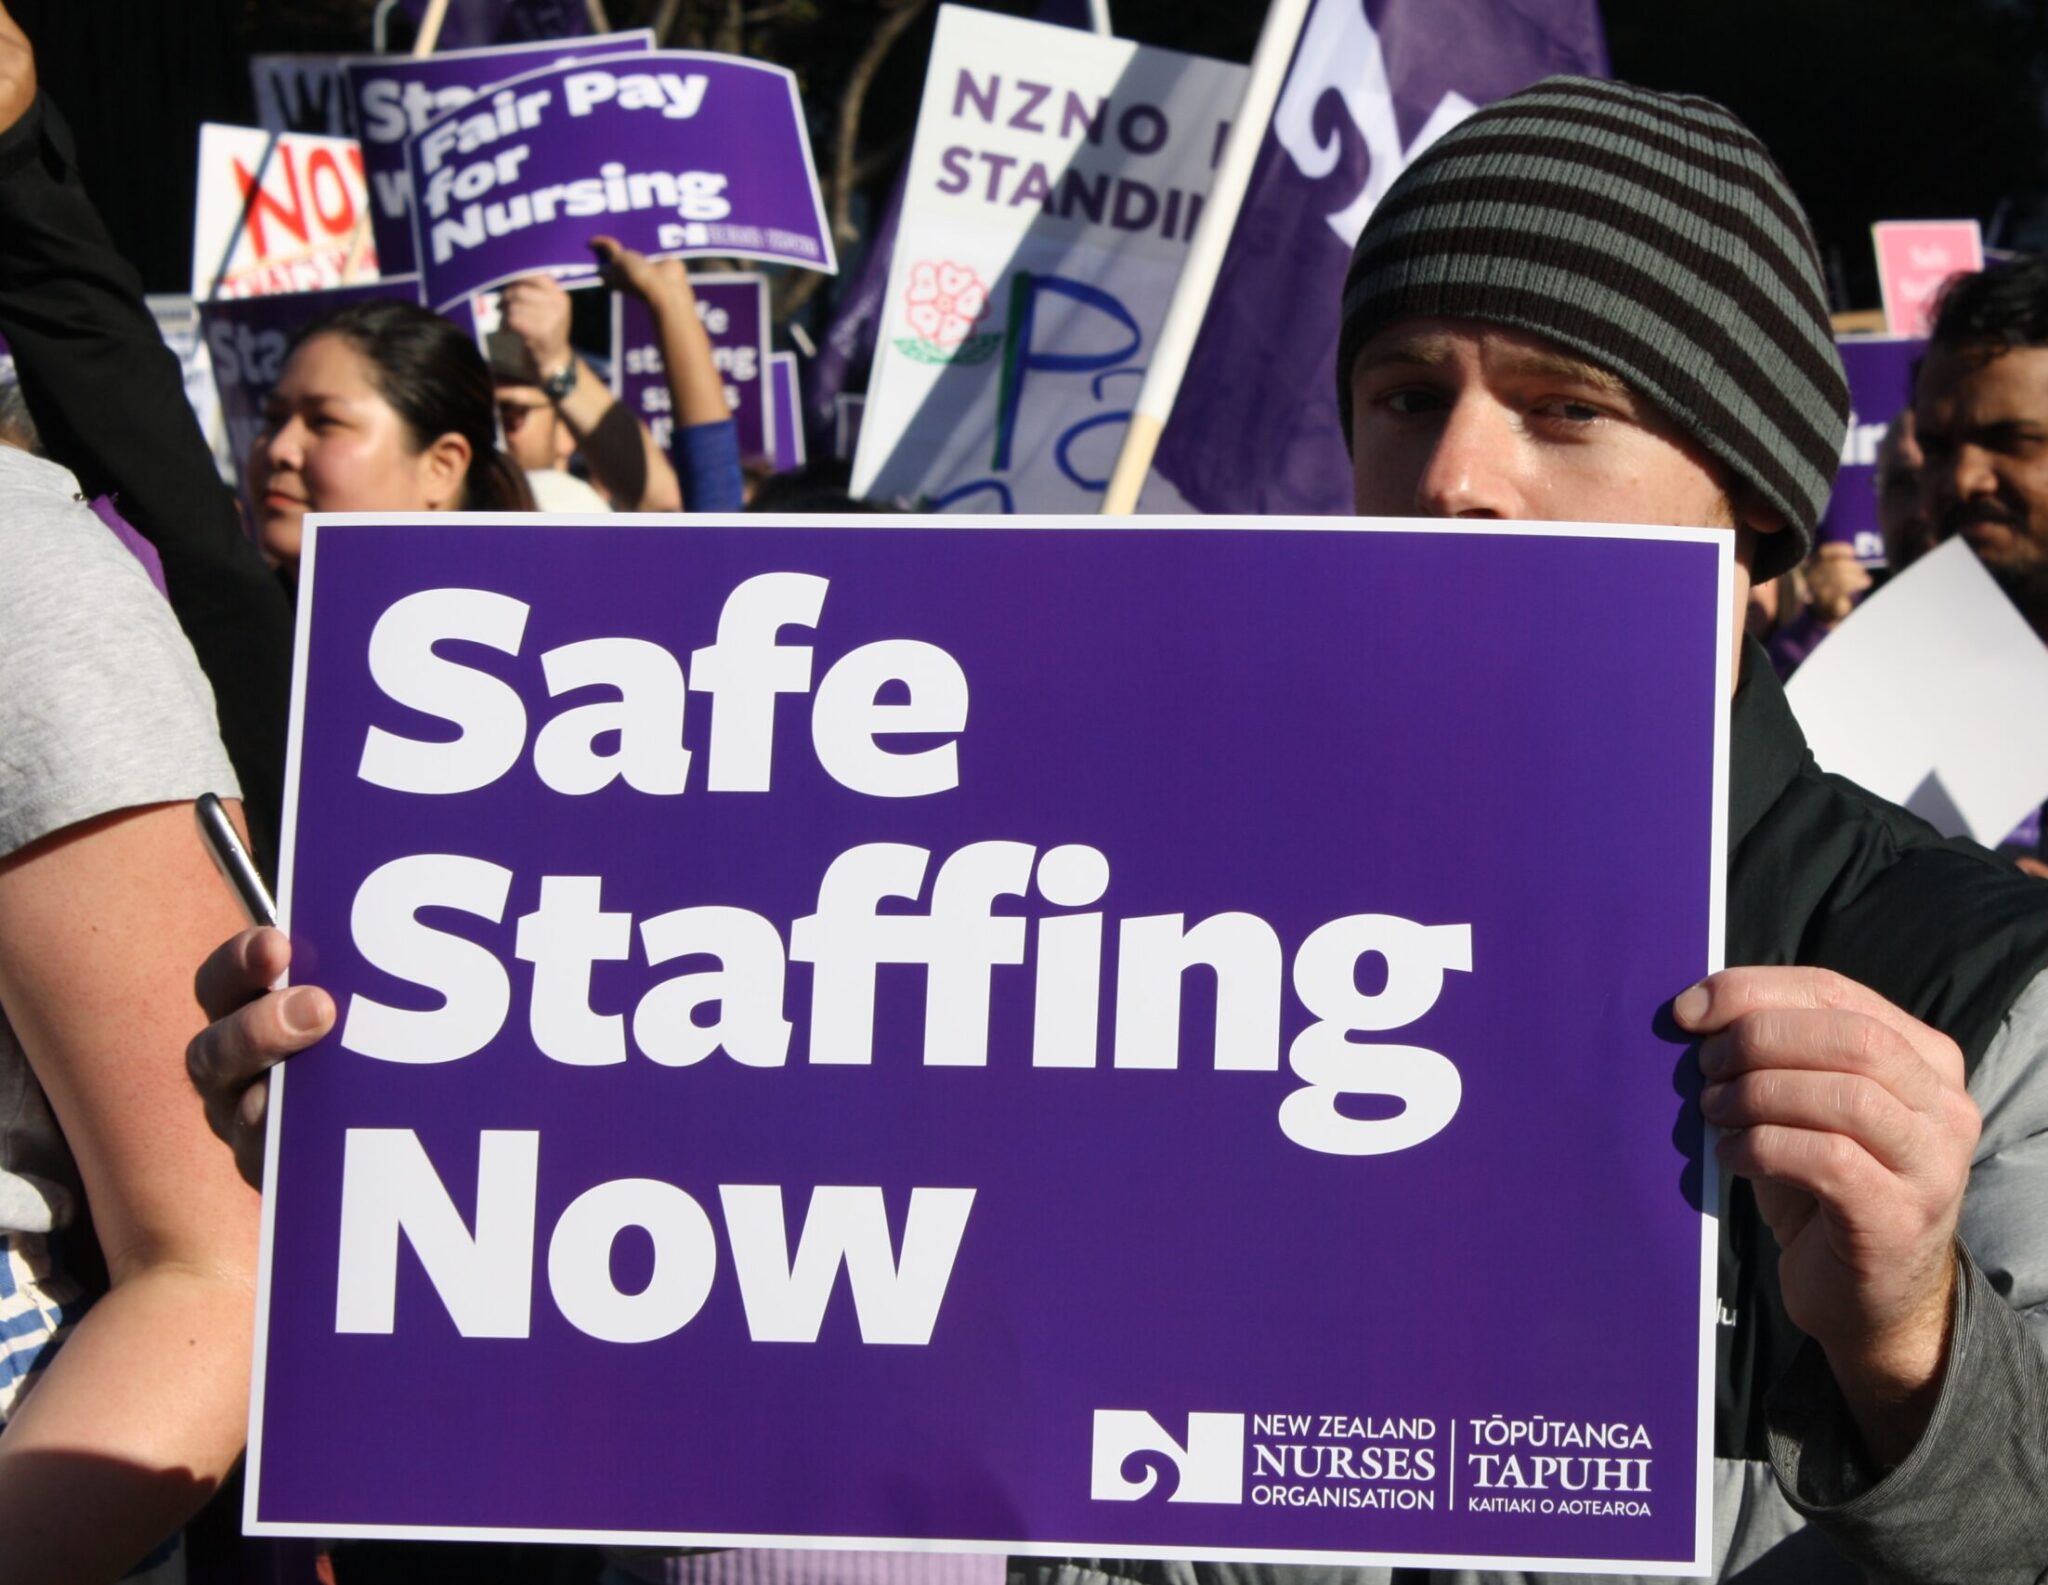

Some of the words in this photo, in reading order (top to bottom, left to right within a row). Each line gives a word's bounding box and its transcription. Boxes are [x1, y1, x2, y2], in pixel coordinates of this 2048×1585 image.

[420, 89, 552, 174] Fair
[564, 71, 709, 119] Pay
[952, 67, 1170, 156] NZNO
[424, 145, 531, 219] for
[431, 162, 732, 265] Nursing
[358, 572, 968, 797] Safe
[341, 841, 1472, 1156] Staffing
[336, 1129, 976, 1345] Now
[1252, 1444, 1436, 1481] NURSES
[1253, 1414, 1311, 1437] NEW
[1319, 1416, 1436, 1440] ZEALAND
[1469, 1414, 1652, 1450] TŌPŪTANGA
[1251, 1485, 1435, 1510] ORGANISATION
[1468, 1454, 1652, 1492] TAPUHI
[1468, 1497, 1536, 1513] KAITIAKI
[1540, 1499, 1555, 1514] O
[1557, 1500, 1652, 1517] AOTEAROA
